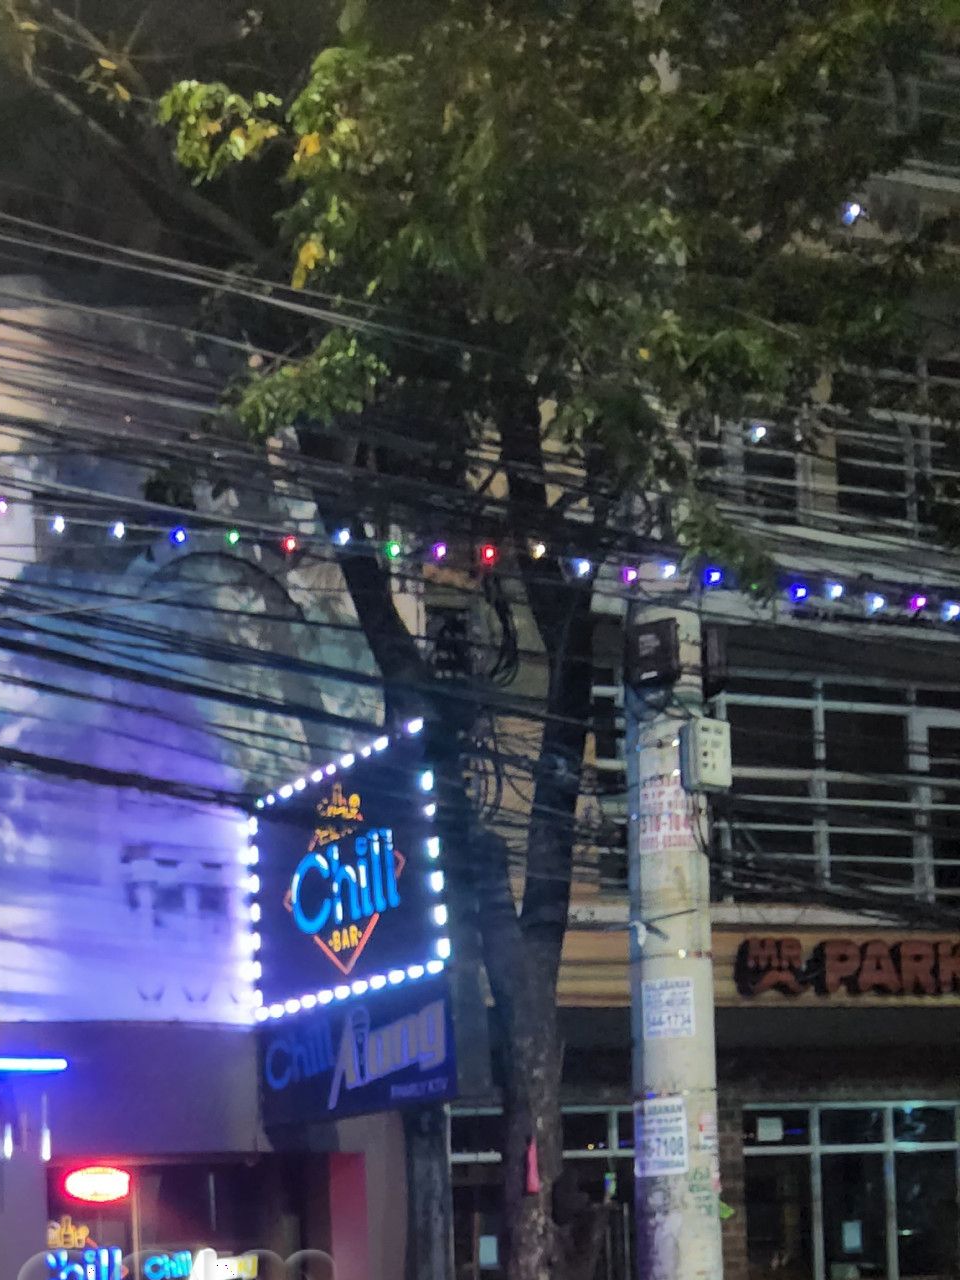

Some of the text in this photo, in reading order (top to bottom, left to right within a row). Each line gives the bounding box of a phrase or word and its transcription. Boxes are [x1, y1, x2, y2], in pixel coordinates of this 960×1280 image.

[291, 826, 401, 935] Chill
[332, 924, 359, 953] BAR
[265, 1014, 336, 1092] Chill
[143, 1250, 192, 1280] Chill
